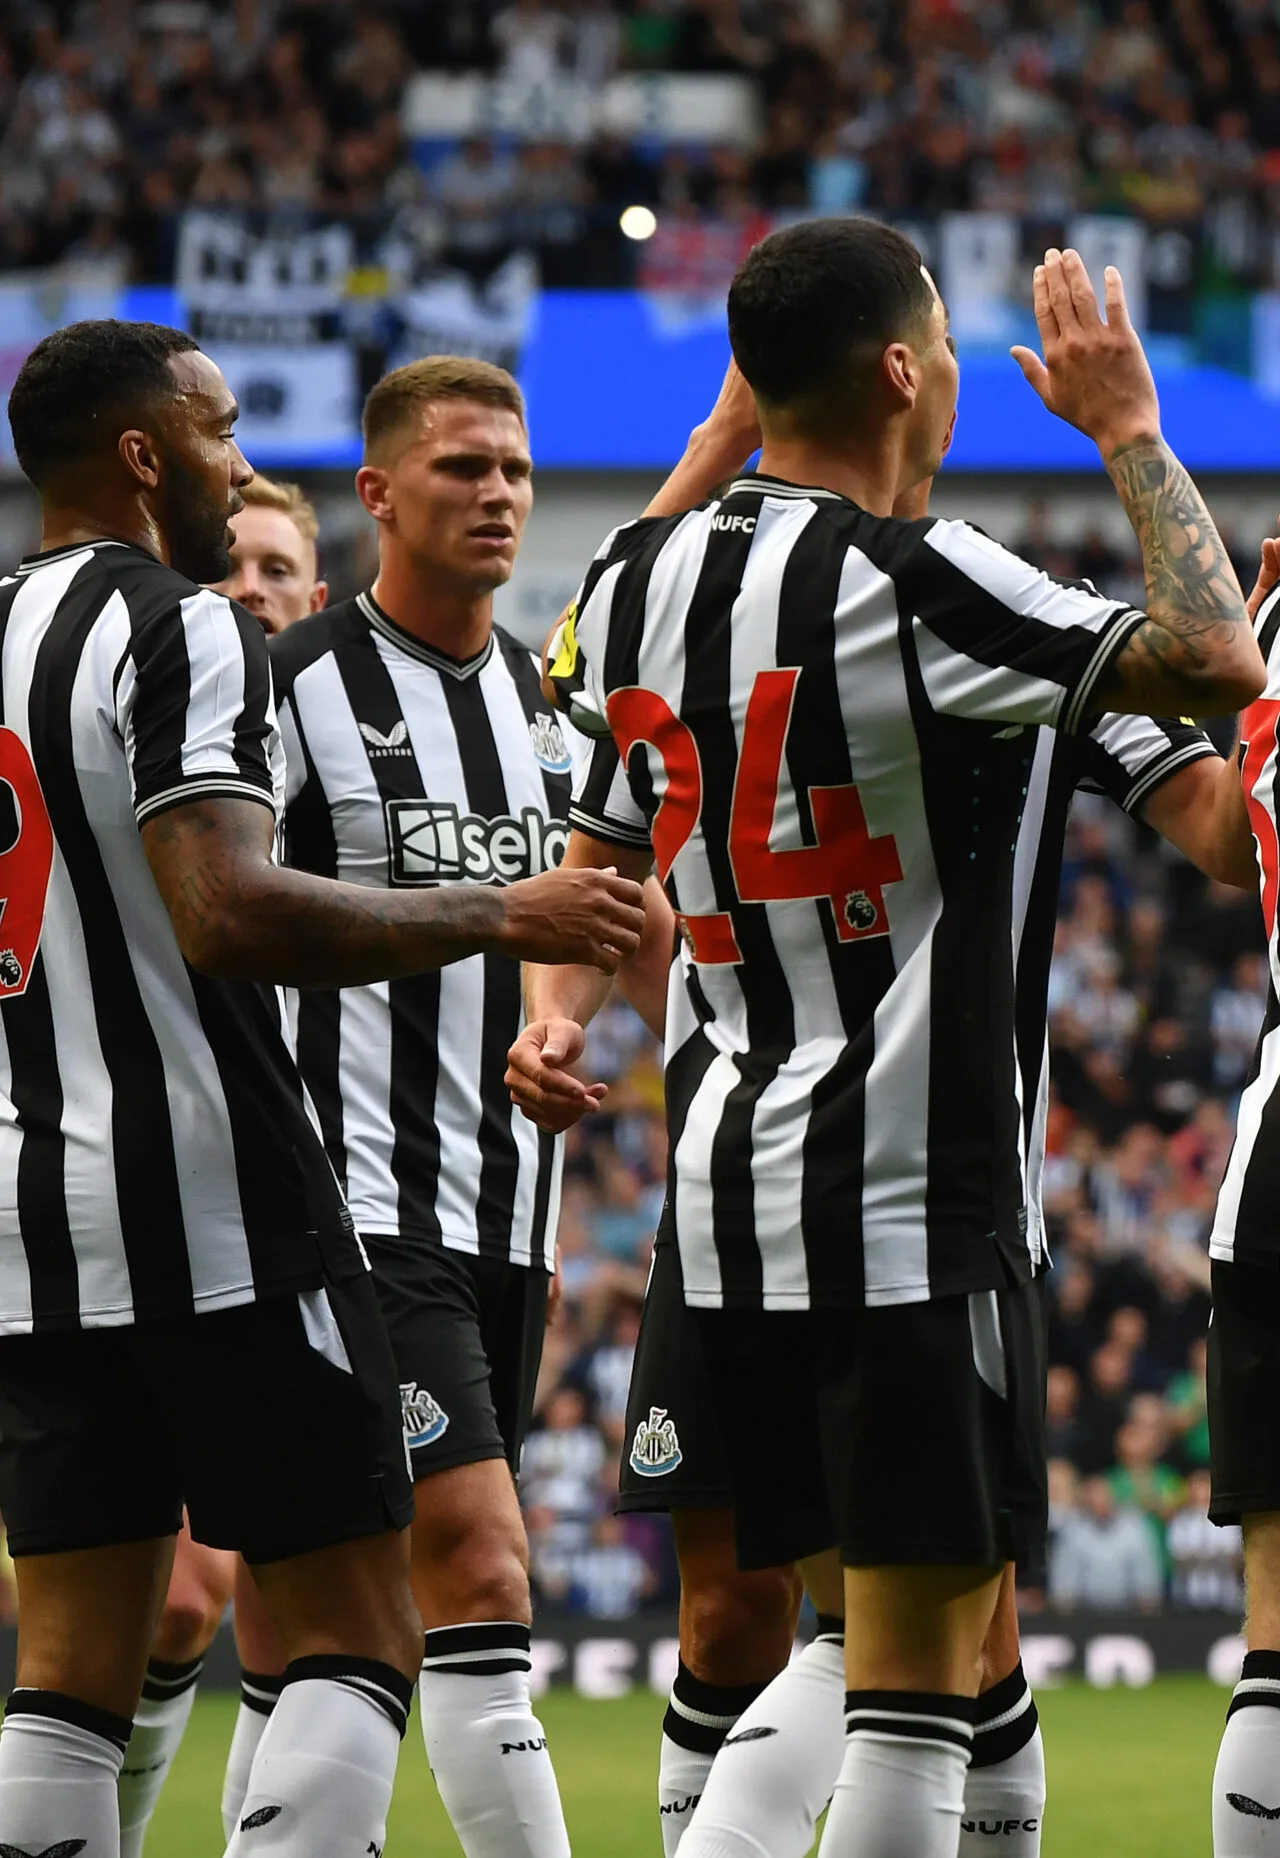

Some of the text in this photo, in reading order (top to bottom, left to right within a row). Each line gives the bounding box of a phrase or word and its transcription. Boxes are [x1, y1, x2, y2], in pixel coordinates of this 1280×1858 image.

[711, 514, 757, 534] NUFC
[605, 666, 904, 965] 24
[960, 1818, 1038, 1835] NUFC
